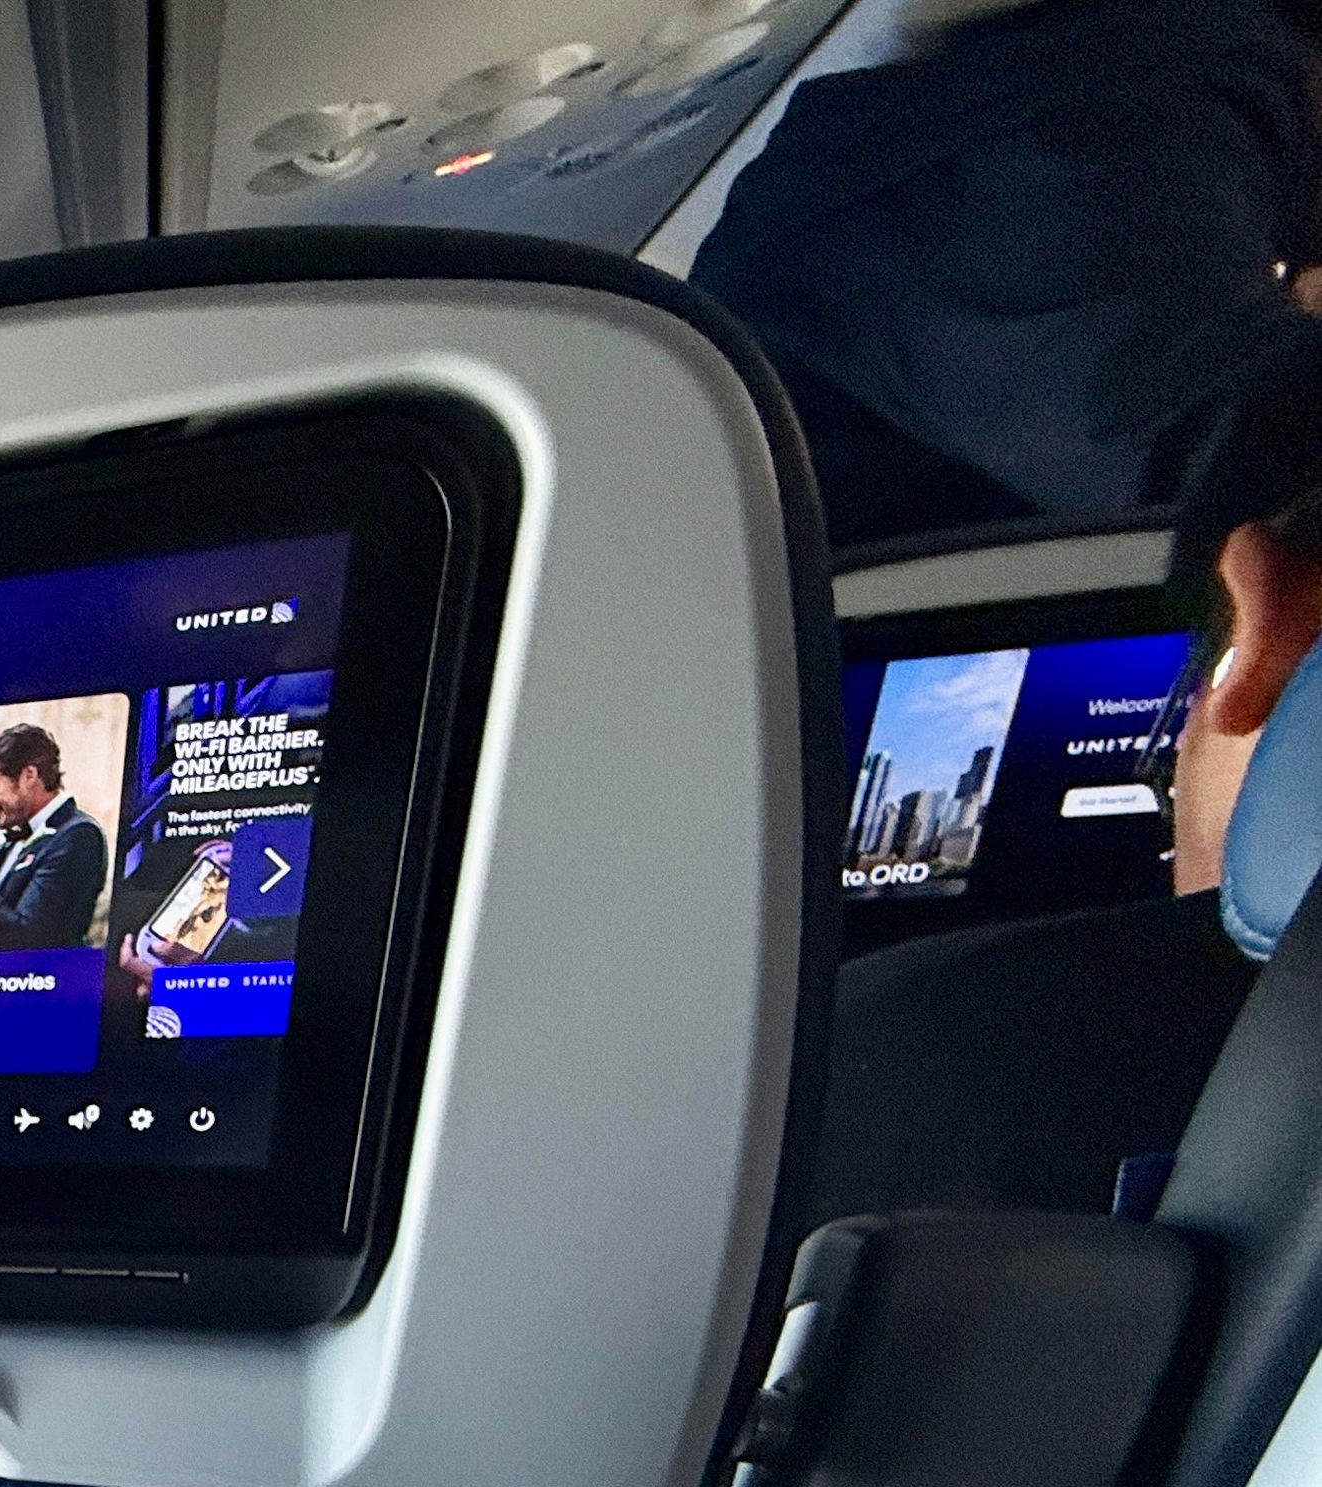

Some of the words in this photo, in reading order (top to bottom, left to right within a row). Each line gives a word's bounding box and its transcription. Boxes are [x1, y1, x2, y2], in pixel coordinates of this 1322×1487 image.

[176, 606, 267, 632] UNITED
[175, 718, 245, 742] BREAK
[249, 713, 289, 734] THE
[174, 738, 226, 759] WI-FI
[228, 729, 325, 754] BARRIER.
[171, 756, 225, 778] ONLY
[227, 751, 283, 773] WITH
[167, 811, 189, 824] The
[190, 808, 232, 822] fastest
[234, 803, 313, 819] connectivity
[165, 826, 177, 837] in
[178, 823, 199, 837] the
[870, 862, 929, 886] ORD
[165, 977, 230, 990] UNITED
